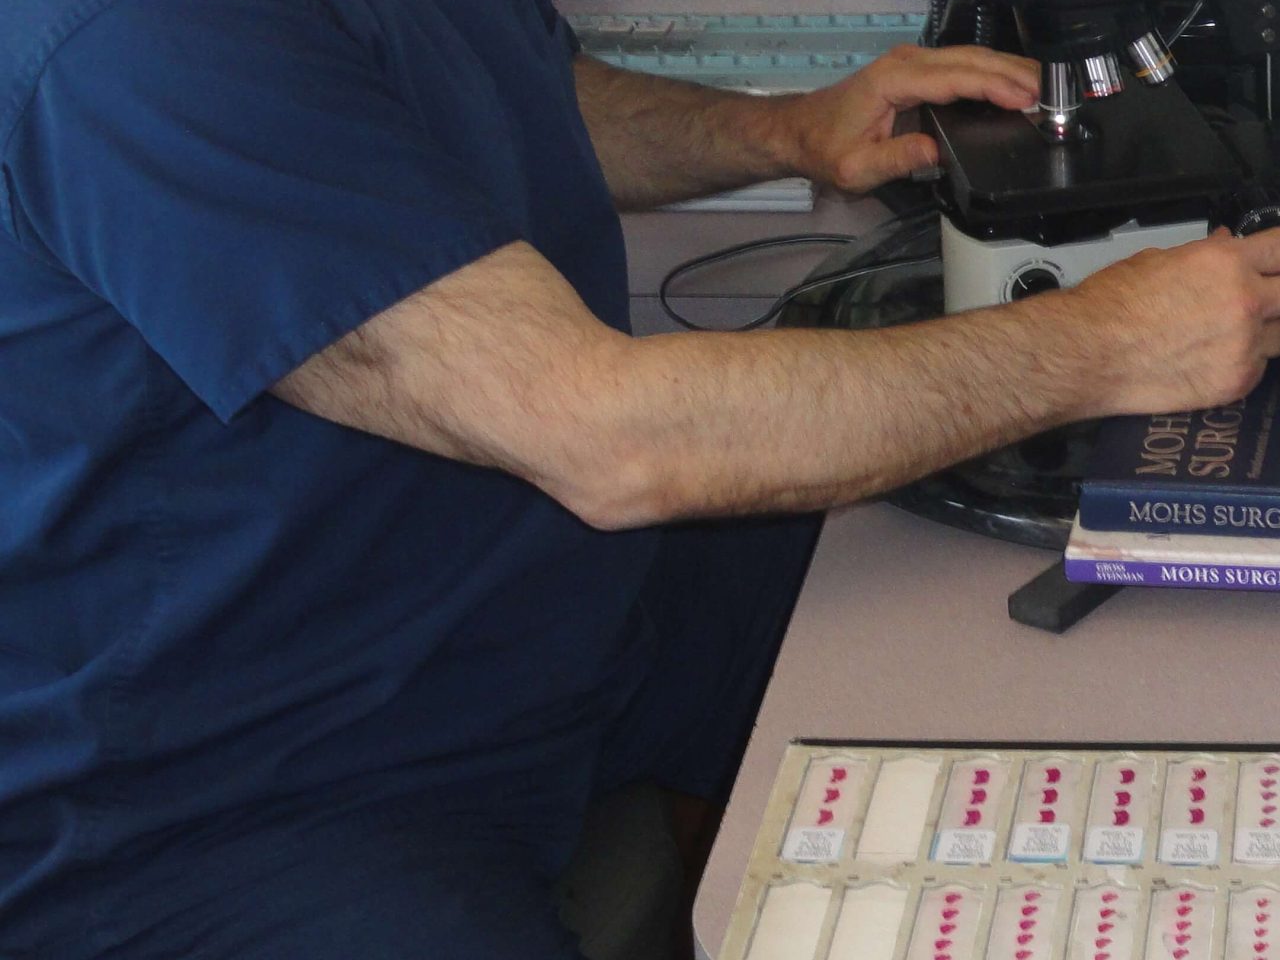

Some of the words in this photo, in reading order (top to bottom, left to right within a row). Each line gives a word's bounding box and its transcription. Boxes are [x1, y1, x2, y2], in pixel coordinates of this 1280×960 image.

[1135, 415, 1192, 476] MOH
[1128, 500, 1207, 525] MOHS
[1096, 570, 1144, 582] STEINMAN
[1160, 566, 1219, 584] MOHS
